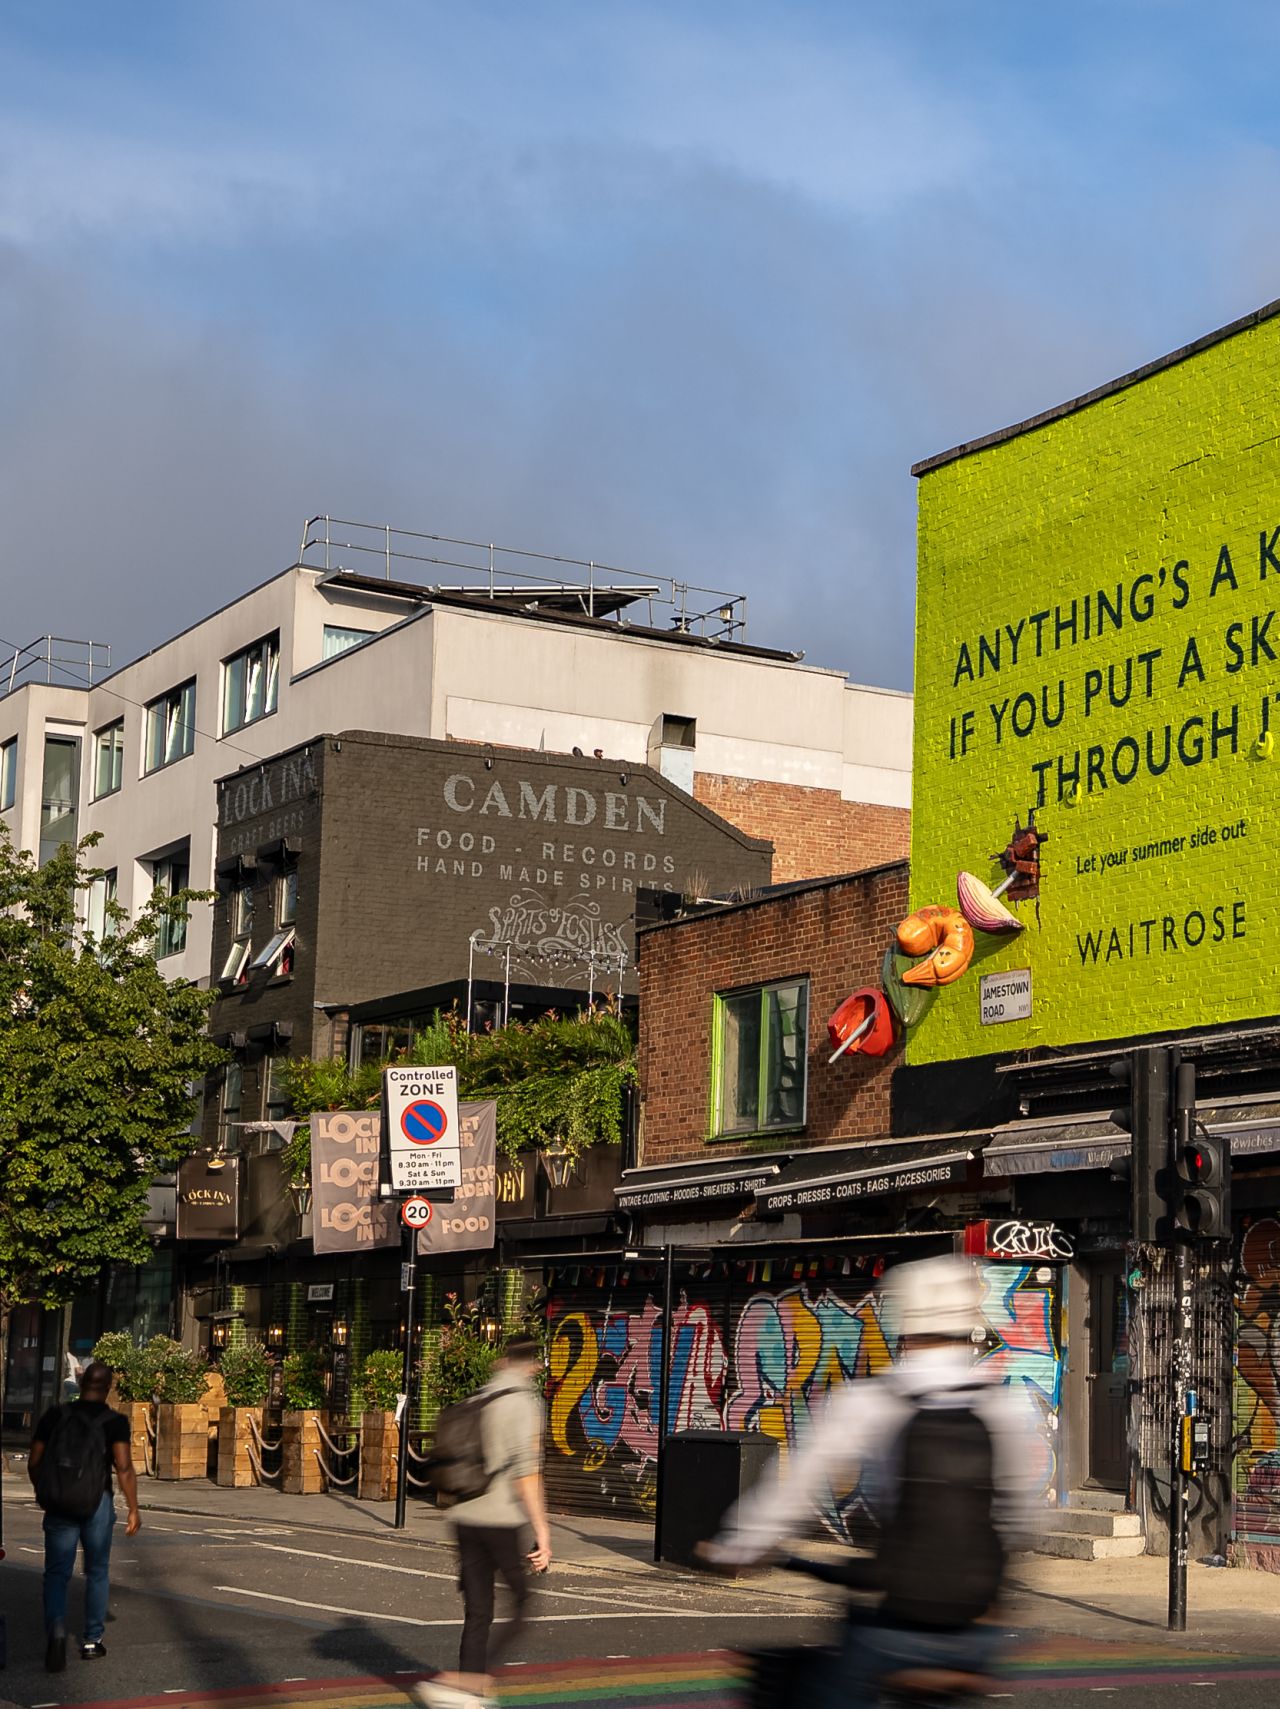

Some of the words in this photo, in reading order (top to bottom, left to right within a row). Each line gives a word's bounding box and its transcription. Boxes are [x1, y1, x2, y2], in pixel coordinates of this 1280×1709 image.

[953, 560, 1190, 687] ANYTHING'S
[1209, 544, 1239, 597] A
[949, 711, 976, 760] IF
[989, 679, 1065, 745] YOU
[1083, 649, 1162, 718] PUT
[1177, 637, 1206, 688] A
[1031, 705, 1239, 808] THROUGH
[223, 771, 274, 827] LOCK
[443, 774, 668, 835] CAMDEN
[417, 828, 496, 854] FOOD
[542, 842, 676, 874] RECORDS
[1076, 855, 1096, 874] Let
[1100, 849, 1129, 875] your
[1132, 836, 1186, 862] summer
[1190, 825, 1217, 849] side
[1221, 819, 1247, 841] out
[417, 856, 484, 877] HAND
[500, 864, 564, 886] MADE
[580, 873, 674, 894] SPIRITS
[1076, 902, 1246, 967] WAITROSE
[983, 981, 1029, 1000] JAMESTOWN
[983, 1004, 1005, 1019] ROAD
[390, 1070, 454, 1082] Controlled
[400, 1083, 445, 1096] ZONE
[410, 1152, 427, 1160] Mon
[431, 1151, 442, 1159] Fri
[618, 1194, 642, 1207] VINTAGE
[642, 1191, 670, 1204] CLOTHING
[673, 1187, 700, 1201] HOODIES
[703, 1182, 735, 1197] SWEATERS
[743, 1178, 766, 1191] SHIRTS
[768, 1193, 793, 1209] CROPS
[797, 1188, 831, 1204] DRESSES
[836, 1182, 862, 1197] COATS
[894, 1166, 951, 1187] ACCESSORIES
[321, 1202, 388, 1232] LOCK
[407, 1206, 429, 1219] 20
[441, 1216, 489, 1235] FOOD
[356, 1222, 388, 1242] INN
